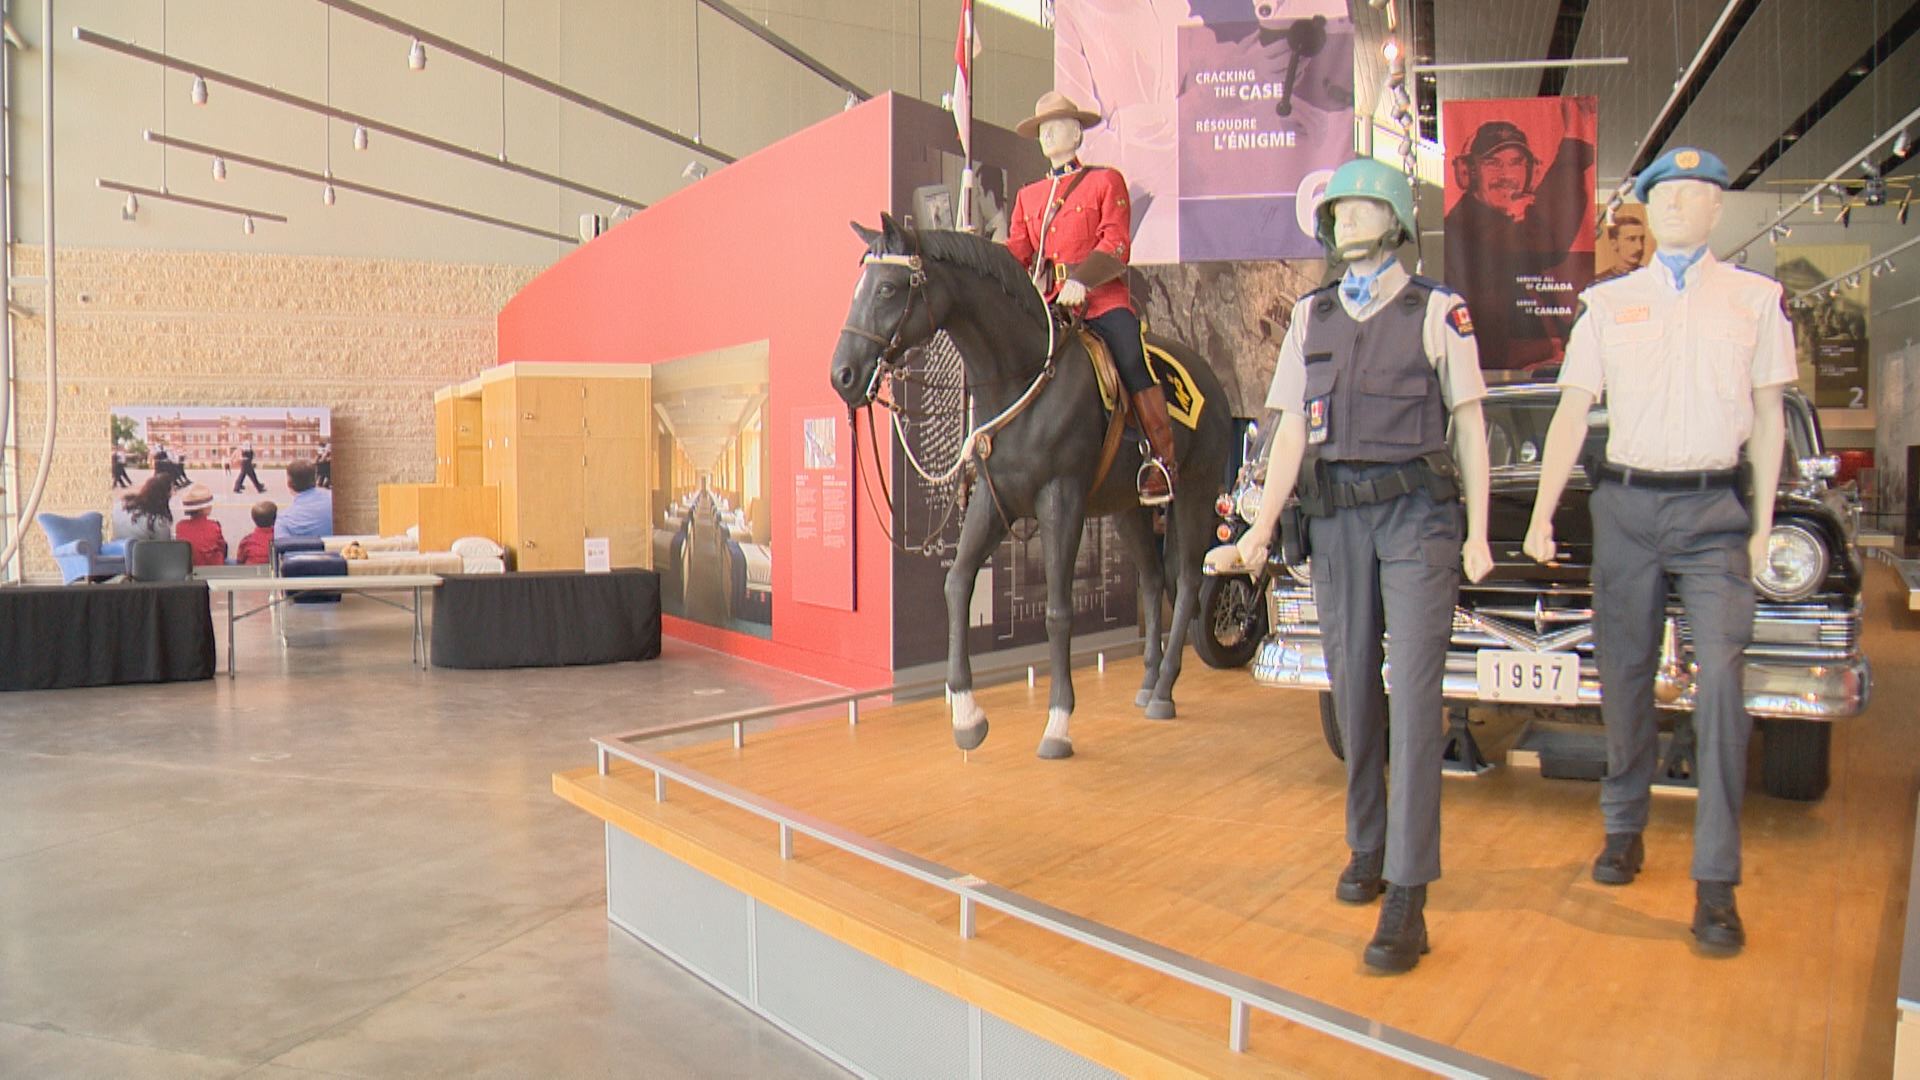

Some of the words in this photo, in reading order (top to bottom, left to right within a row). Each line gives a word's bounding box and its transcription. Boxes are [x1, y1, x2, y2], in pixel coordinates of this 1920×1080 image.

[1196, 69, 1256, 84] CRACKING
[1214, 85, 1236, 98] THE
[1239, 82, 1283, 100] CASE
[1196, 118, 1256, 133] RÉSOUDRE
[1214, 131, 1296, 150] L'ÉNIGME
[1535, 282, 1573, 292] CANADA
[1534, 306, 1572, 315] CANADA
[1849, 387, 1864, 408] 2
[1494, 663, 1562, 690] 1957
